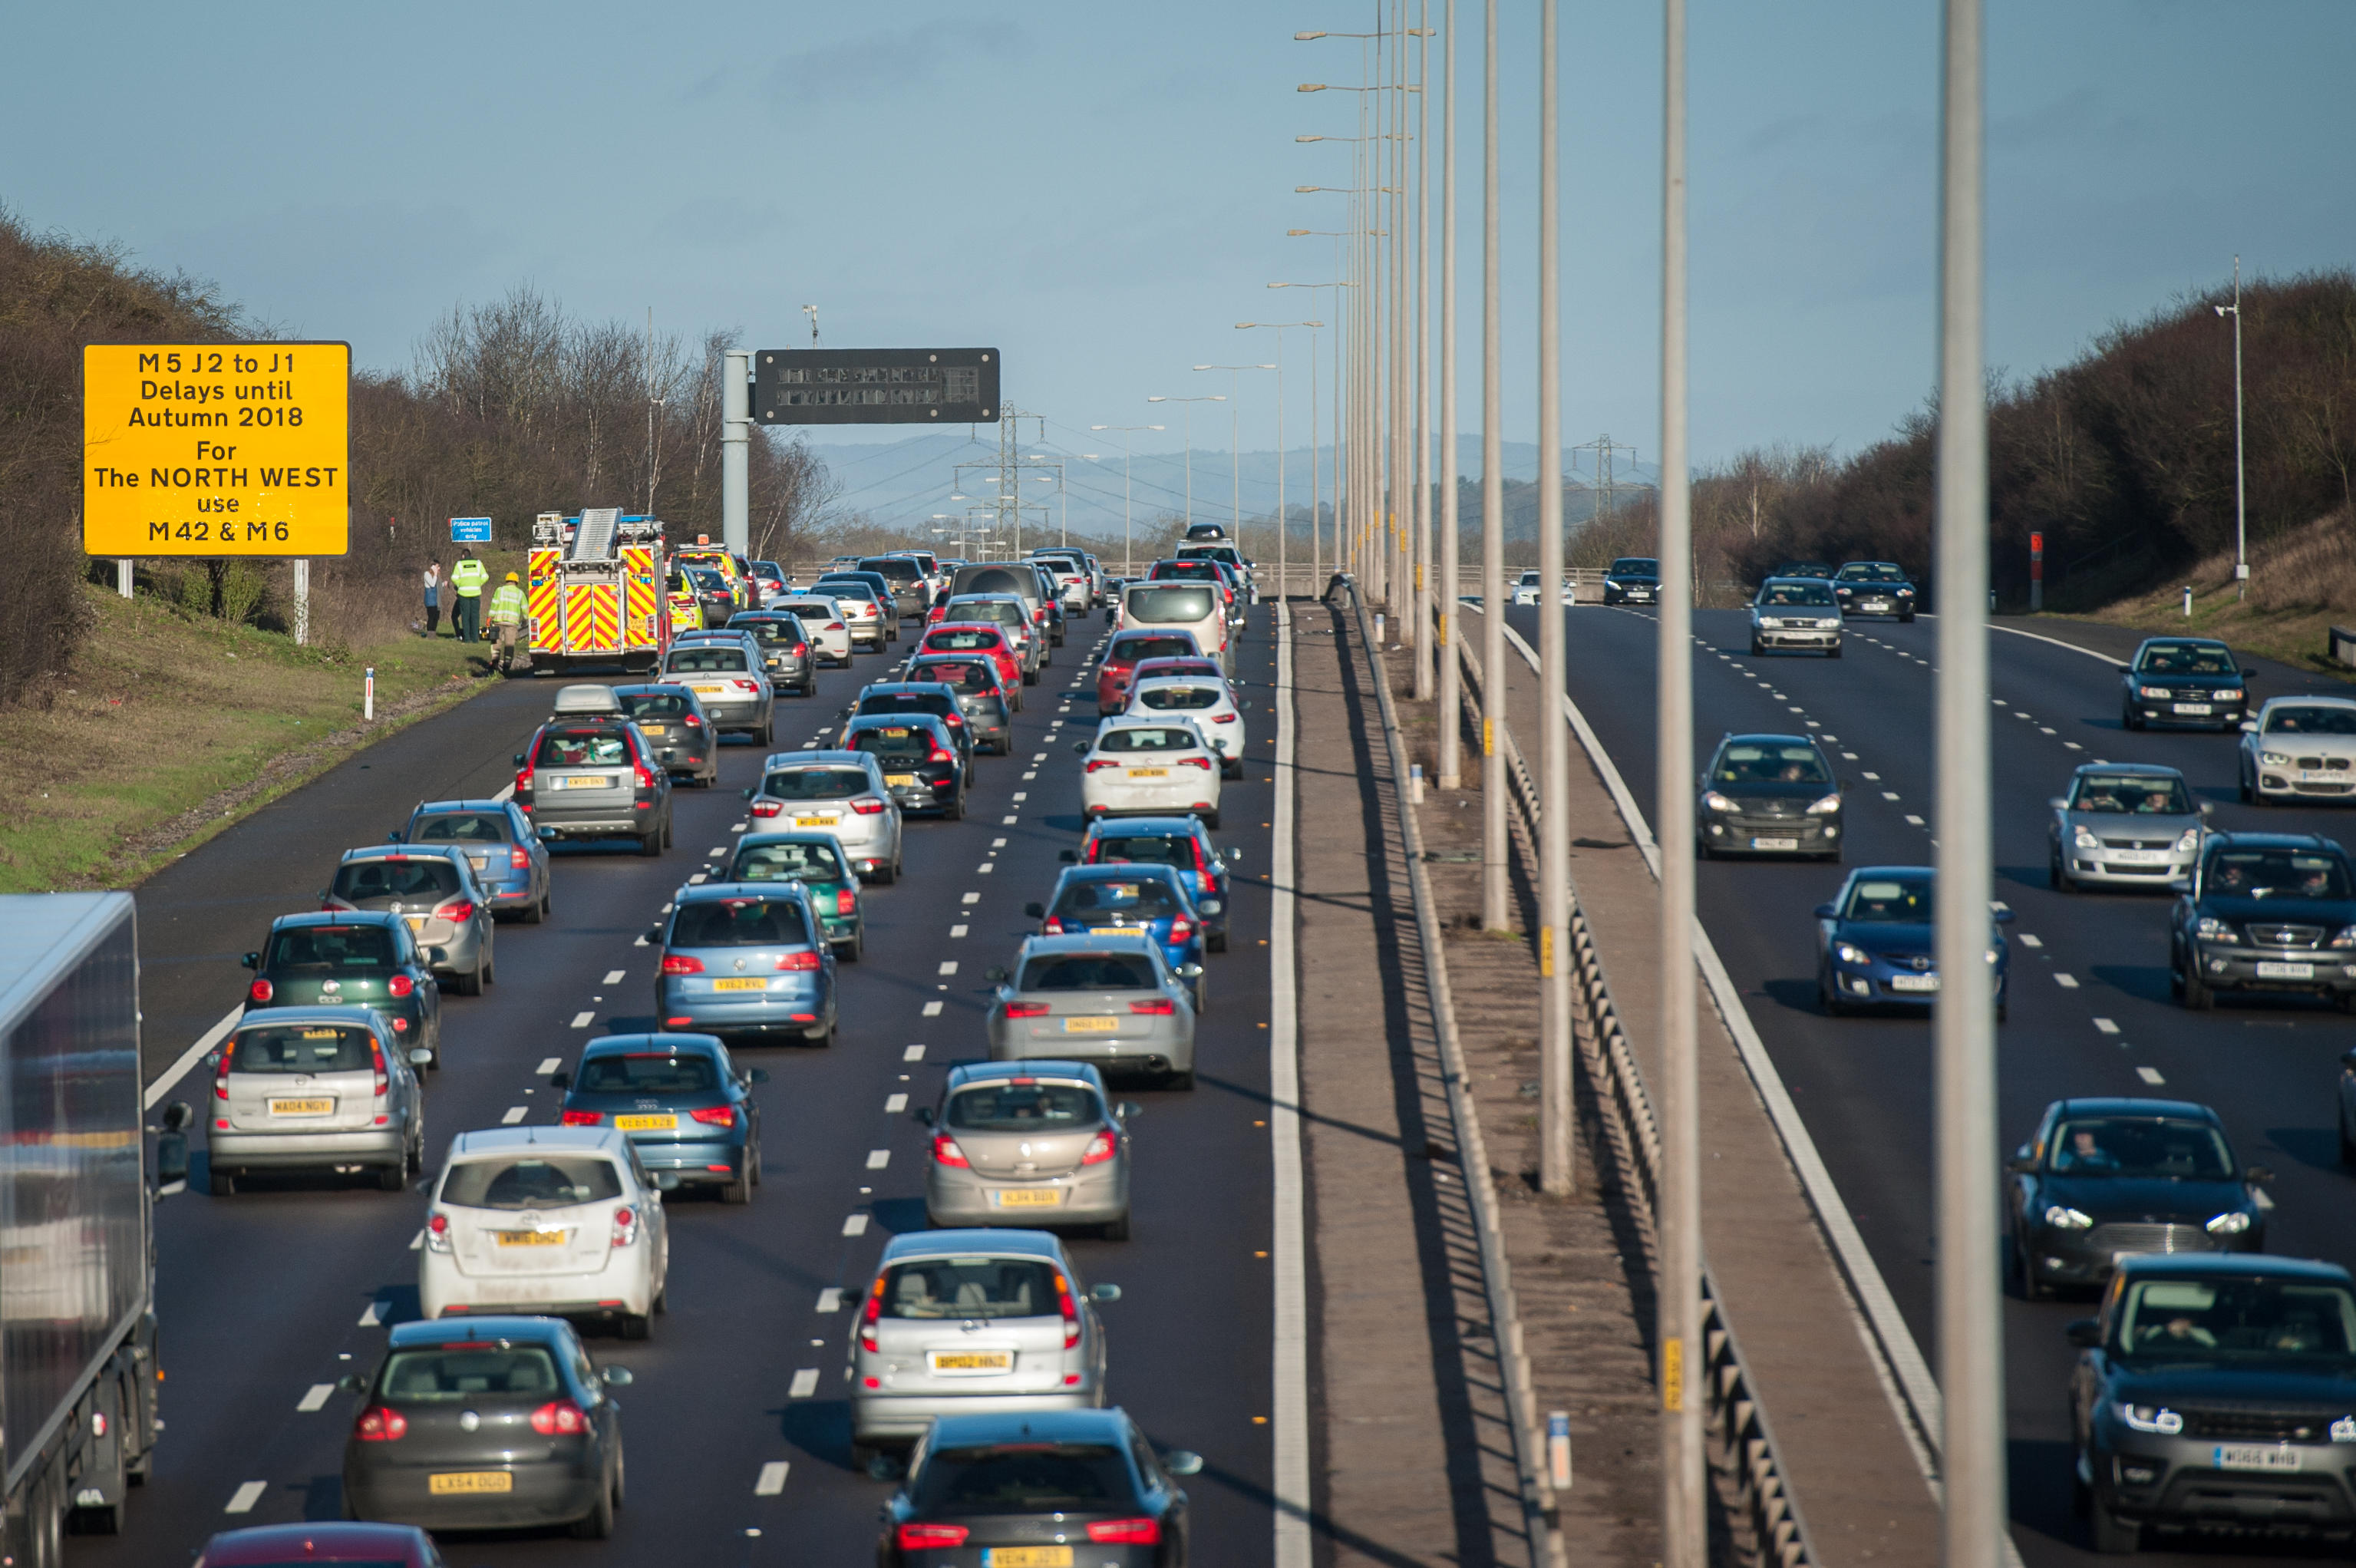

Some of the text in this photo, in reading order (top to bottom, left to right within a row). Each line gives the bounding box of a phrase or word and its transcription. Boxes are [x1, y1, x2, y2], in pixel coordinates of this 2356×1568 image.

[233, 354, 258, 373] to
[141, 380, 292, 404] Delays until
[128, 407, 303, 427] Autumn 2018
[197, 441, 237, 460] For
[94, 467, 338, 487] The NORTH WEST
[197, 498, 239, 513] use
[149, 521, 289, 541] M42 & M6
